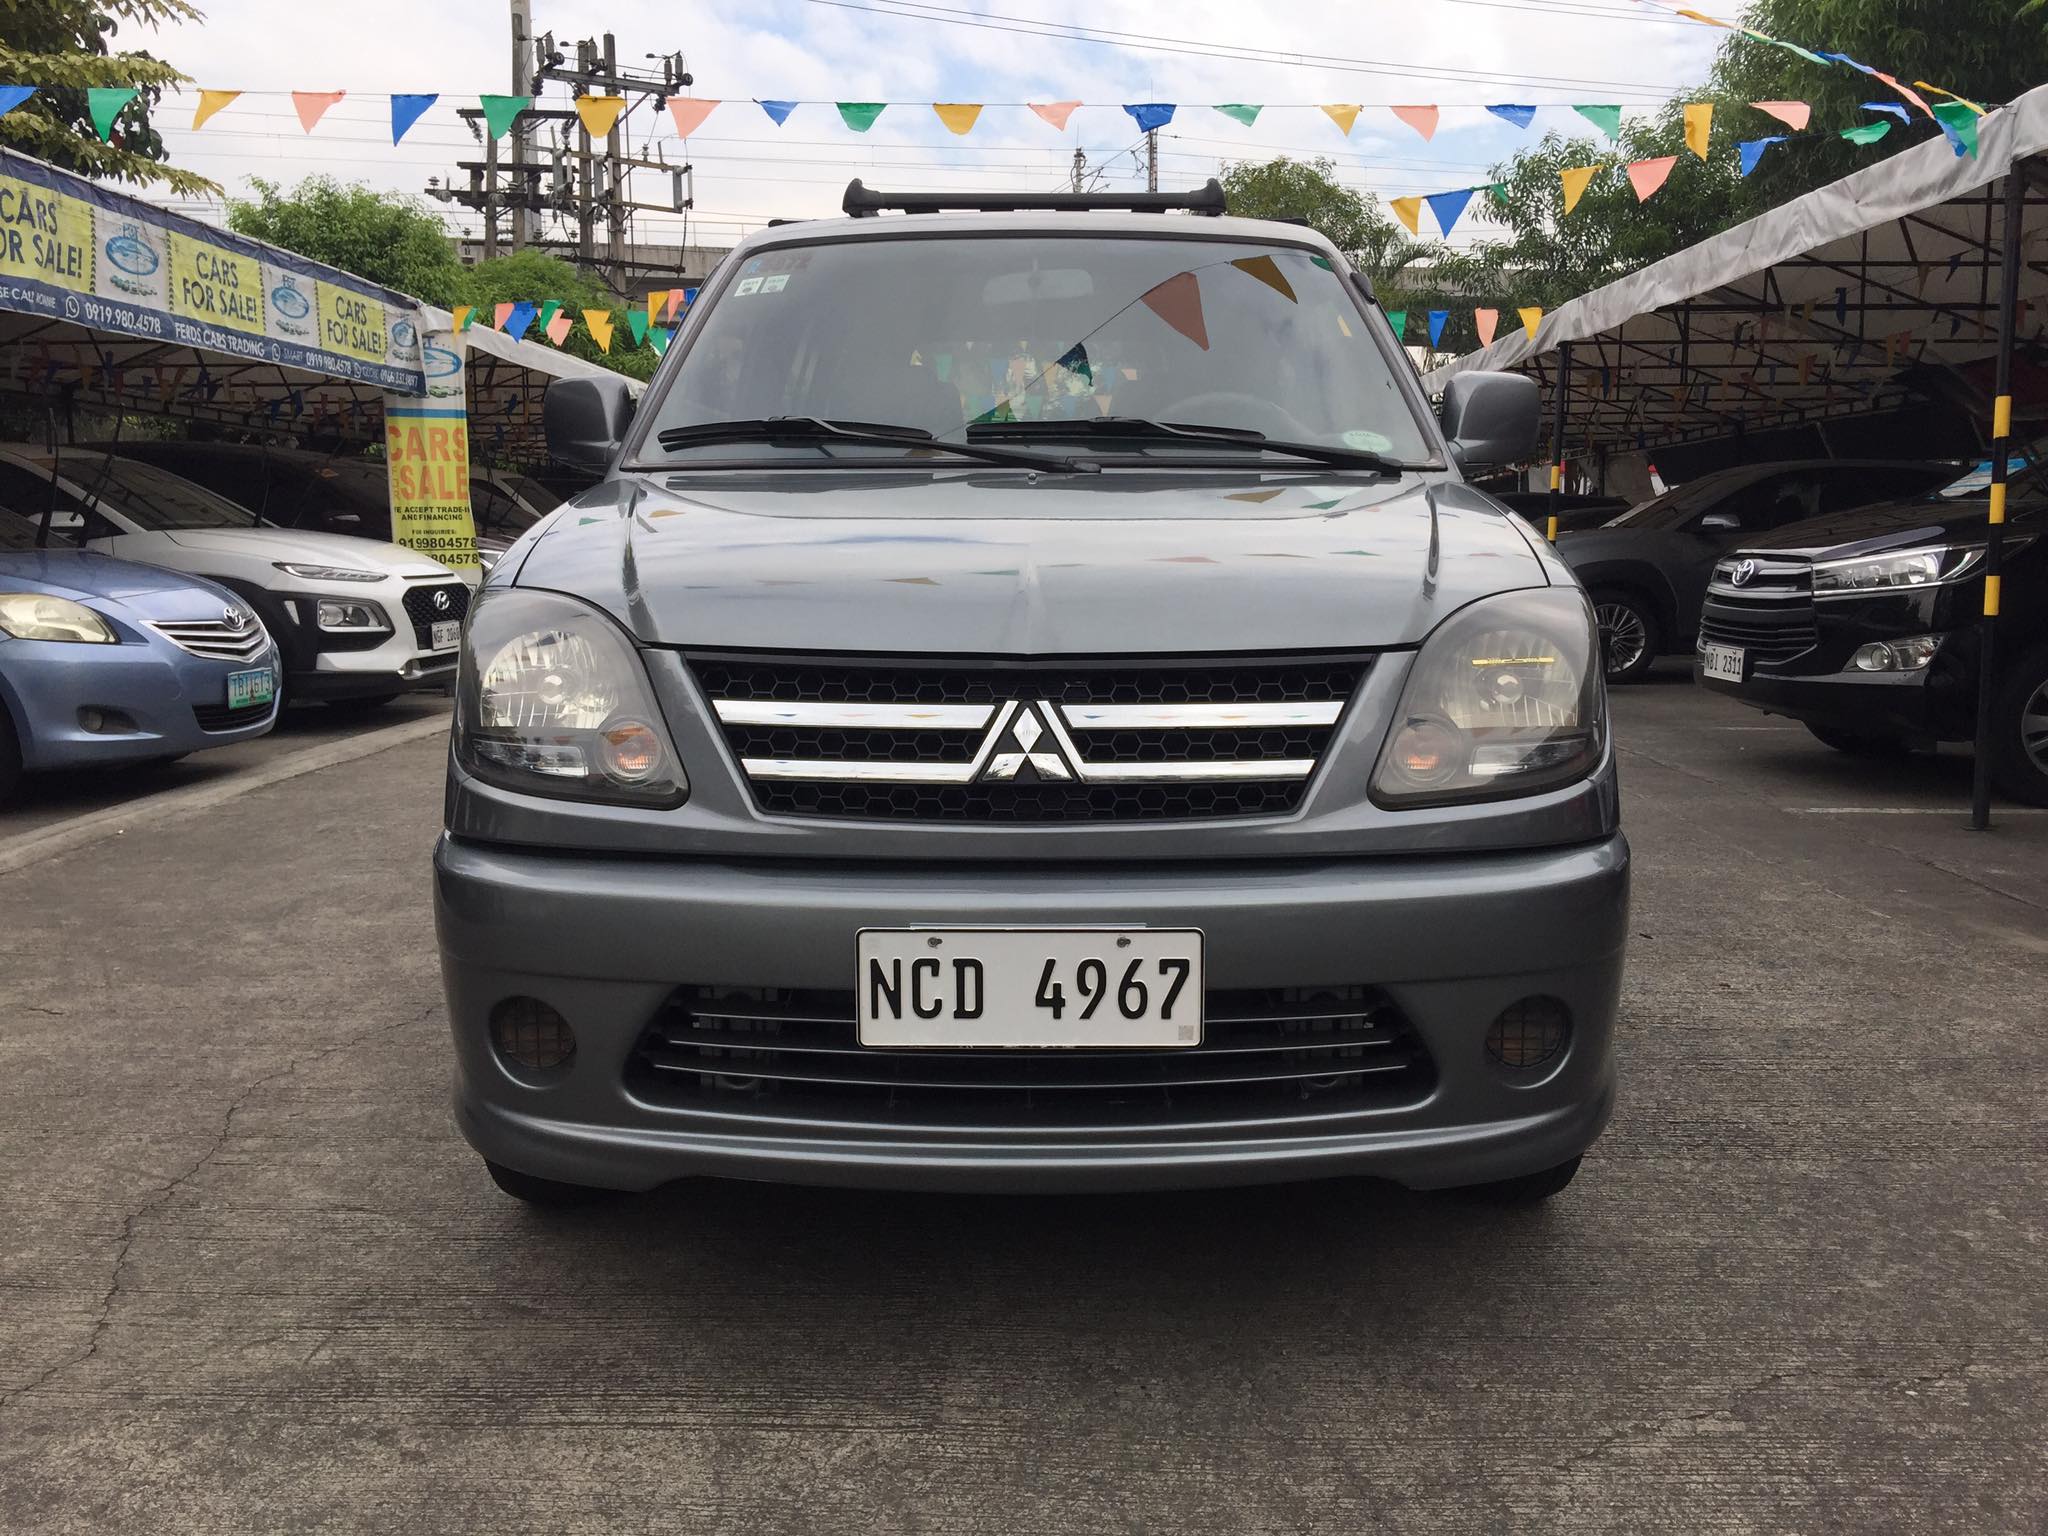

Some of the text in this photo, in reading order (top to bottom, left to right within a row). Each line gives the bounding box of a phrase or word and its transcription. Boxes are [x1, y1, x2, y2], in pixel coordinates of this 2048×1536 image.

[0, 188, 57, 235] CARS
[33, 234, 82, 278] SALE!
[196, 251, 238, 289] CARS
[11, 287, 34, 303] CALL
[85, 302, 161, 334] 0919.980.4578
[183, 278, 257, 323] FOR SALE!
[335, 295, 368, 326] CARS
[174, 322, 201, 343] FERDS
[203, 329, 227, 348] CARS
[227, 334, 265, 358] TRADING
[326, 319, 383, 356] FOR SALE!
[388, 425, 467, 462] CARS
[399, 465, 469, 500] SALE
[1722, 655, 1741, 676] 2311
[869, 957, 1191, 1020] NCD 4967
